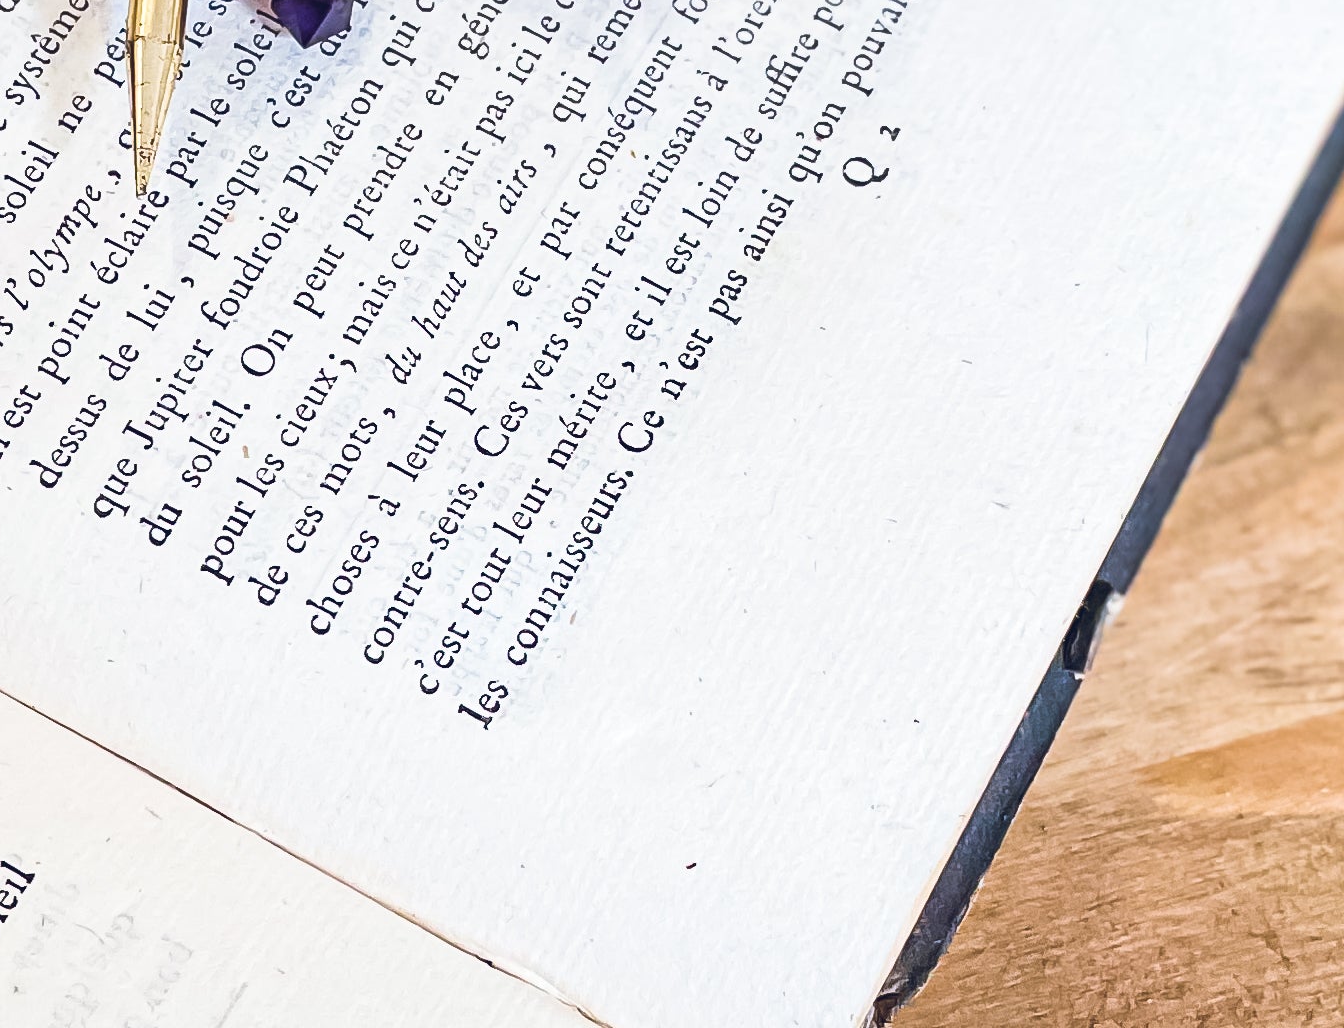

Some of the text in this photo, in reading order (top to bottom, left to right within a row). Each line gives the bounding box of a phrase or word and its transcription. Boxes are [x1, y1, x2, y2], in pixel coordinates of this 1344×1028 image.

[56, 94, 94, 135] ne
[680, 170, 741, 230] loin
[723, 126, 764, 164] de
[757, 32, 820, 121] suffire
[27, 51, 322, 490] dessus de puisque c'est
[36, 292, 102, 387] point
[164, 130, 209, 190] par
[188, 91, 232, 129] le
[92, 457, 139, 520] que
[120, 337, 215, 453] Jupiter
[199, 205, 300, 332] foudroie
[281, 78, 385, 198] Phaéton
[380, 12, 423, 68] qui
[137, 502, 184, 548] du
[180, 398, 253, 490] soleil.
[239, 328, 295, 378] On
[291, 242, 346, 321] peut
[341, 122, 424, 243] prendre
[424, 70, 461, 107] en
[198, 41, 544, 588] pour les mais ce n'était pas ici
[246, 69, 592, 608] de ces du haut des qui
[304, 529, 381, 637] choses
[385, 418, 448, 484] leur
[511, 265, 542, 299] et
[538, 200, 582, 262] par
[577, 34, 684, 191] conséquent
[664, 231, 702, 276] est
[362, 261, 614, 666] contre-sens. Ces vers sont
[453, 678, 510, 732] les
[505, 469, 636, 667] connaisseurs.
[616, 409, 666, 455] Ce
[657, 327, 715, 402] n'est
[707, 268, 749, 327] pas
[737, 187, 796, 263] ainsi
[787, 102, 848, 185] qu'on
[490, 476, 554, 546] leur
[412, 620, 471, 696] c'est
[460, 546, 513, 617] tout
